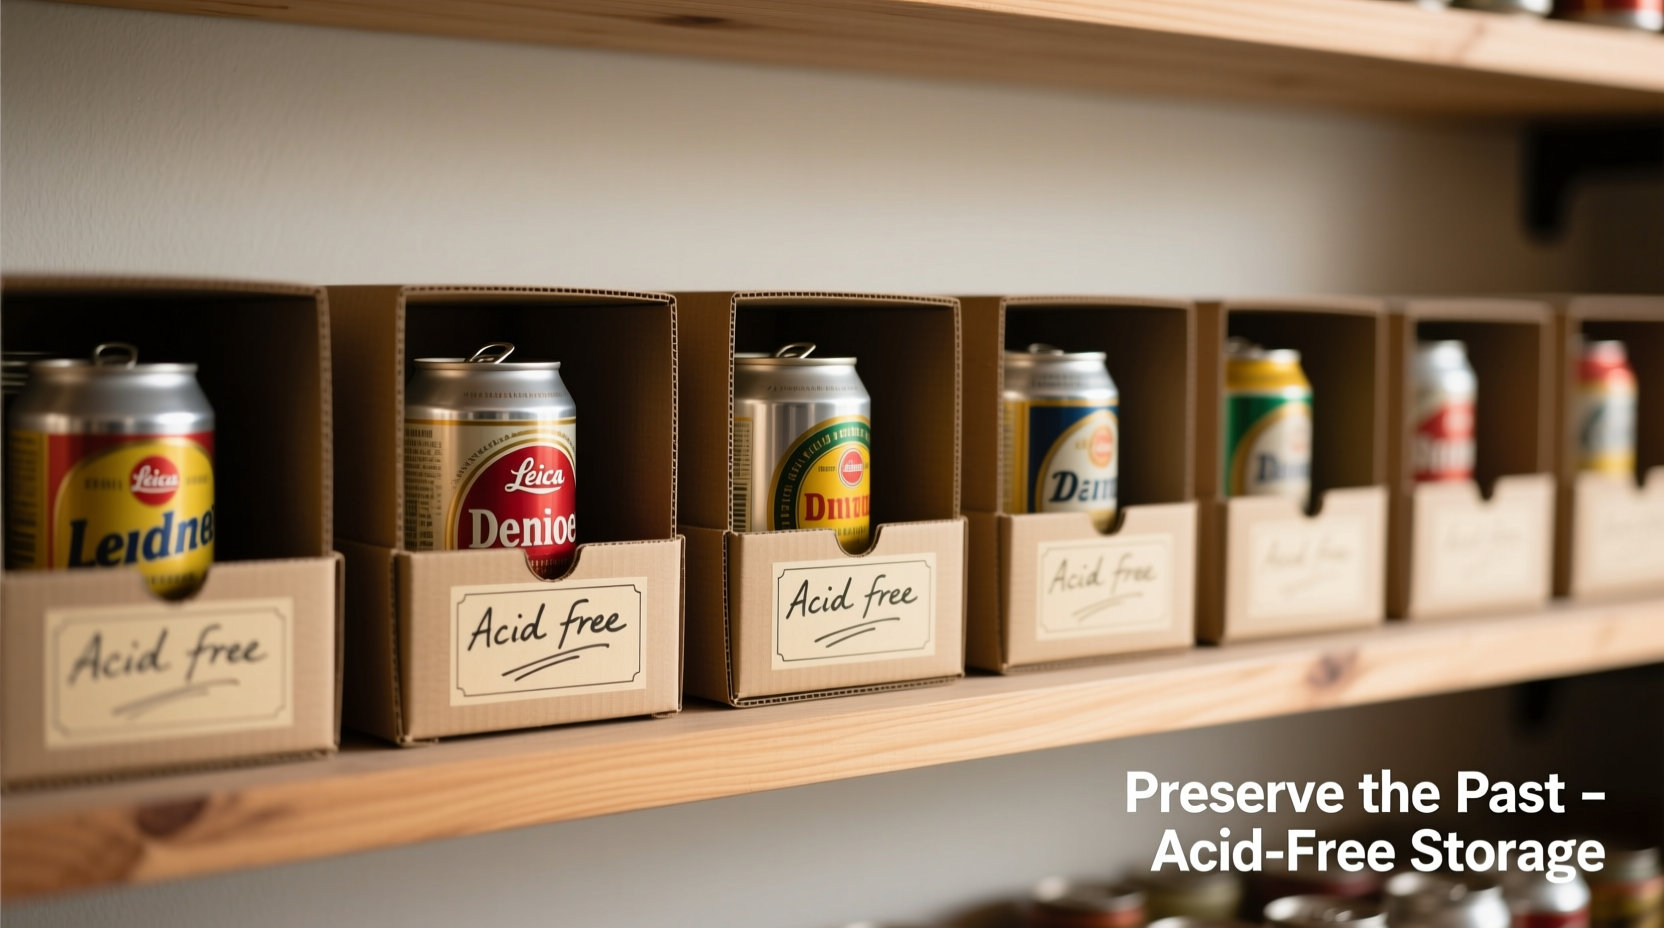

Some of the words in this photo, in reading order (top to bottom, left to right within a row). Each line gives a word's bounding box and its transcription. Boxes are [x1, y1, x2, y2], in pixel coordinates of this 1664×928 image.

[131, 465, 179, 494] Leica
[504, 457, 565, 494] Leica
[1047, 555, 1104, 595] Acid
[1110, 552, 1157, 595] free
[785, 577, 854, 620] Acid
[862, 574, 918, 619] free
[467, 603, 547, 651] Acid
[558, 598, 627, 650] free
[67, 626, 171, 686] Acid
[185, 622, 268, 684] free
